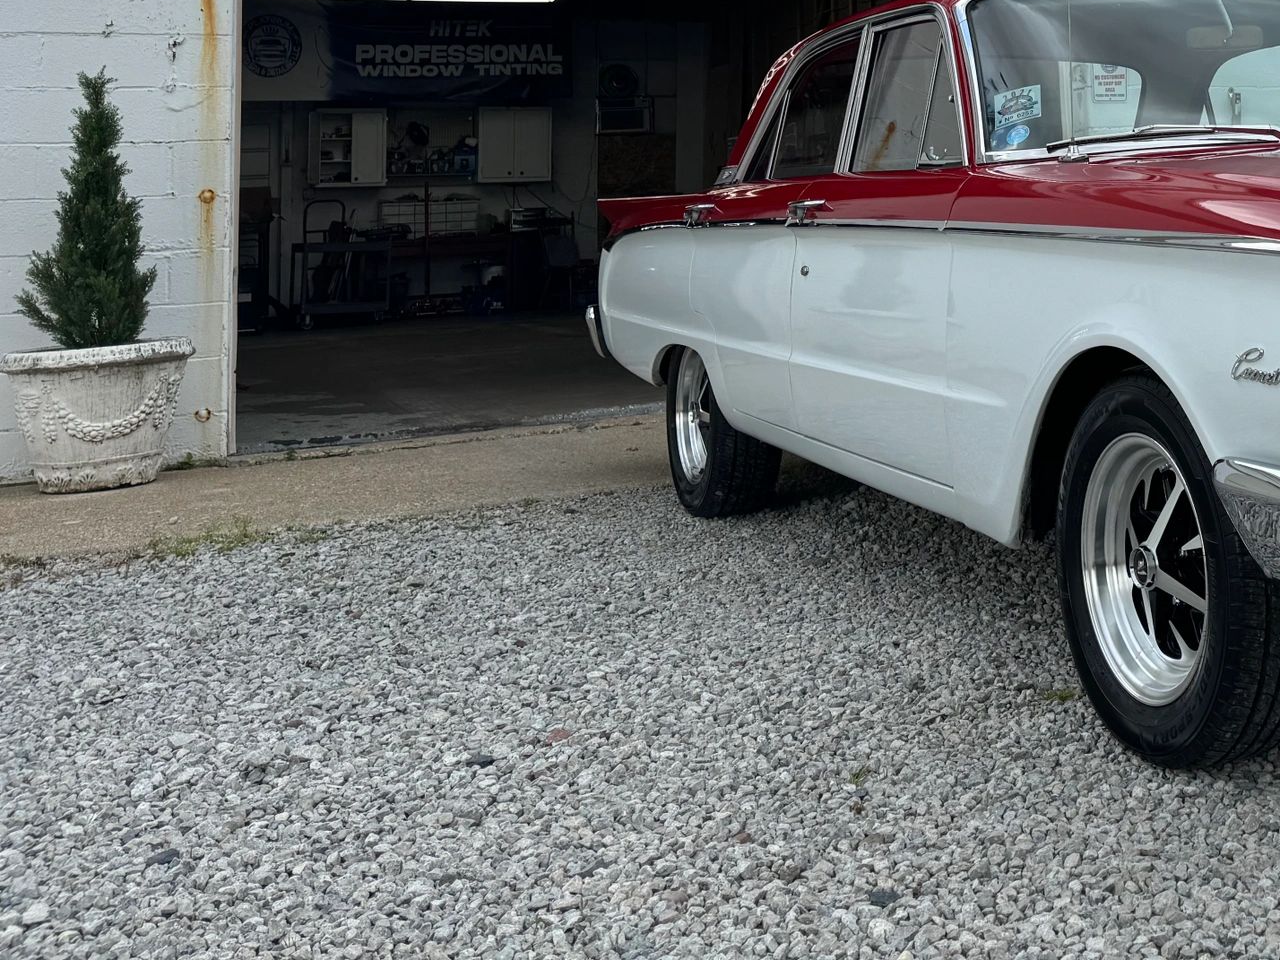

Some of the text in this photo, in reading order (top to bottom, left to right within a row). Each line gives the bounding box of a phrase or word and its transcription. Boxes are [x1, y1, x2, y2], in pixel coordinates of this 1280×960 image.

[429, 19, 494, 37] HITEK
[355, 43, 563, 63] PROFESSIONAL
[356, 63, 563, 77] WINDOW TINTING
